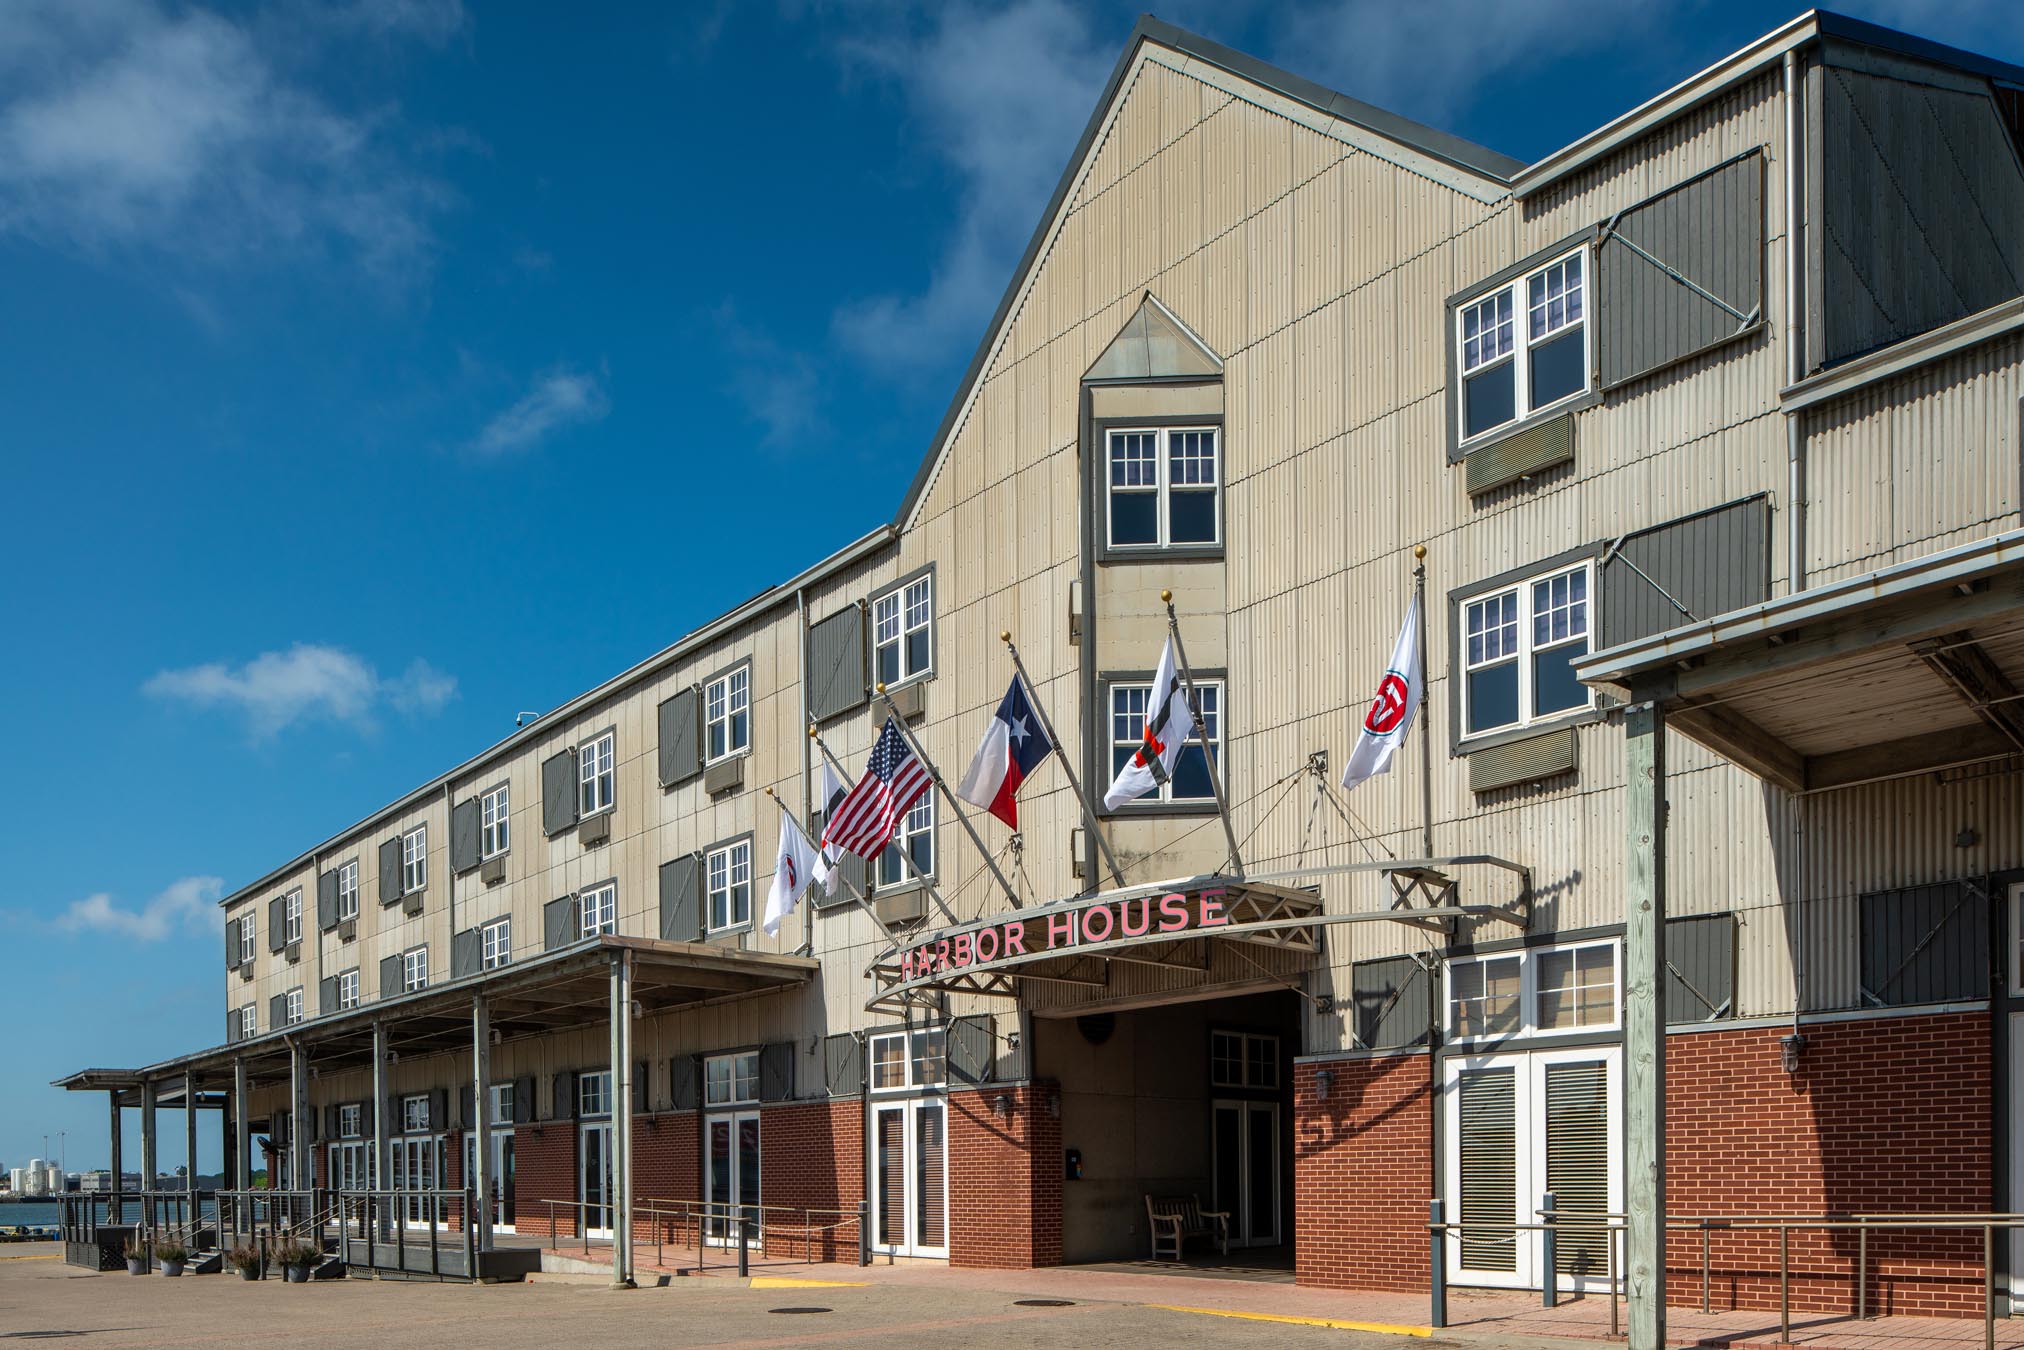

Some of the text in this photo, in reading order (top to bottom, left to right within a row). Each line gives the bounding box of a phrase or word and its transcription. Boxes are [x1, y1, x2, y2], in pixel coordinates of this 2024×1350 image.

[1373, 683, 1403, 726] 21
[900, 889, 1229, 983] HARBOR HOUSE
